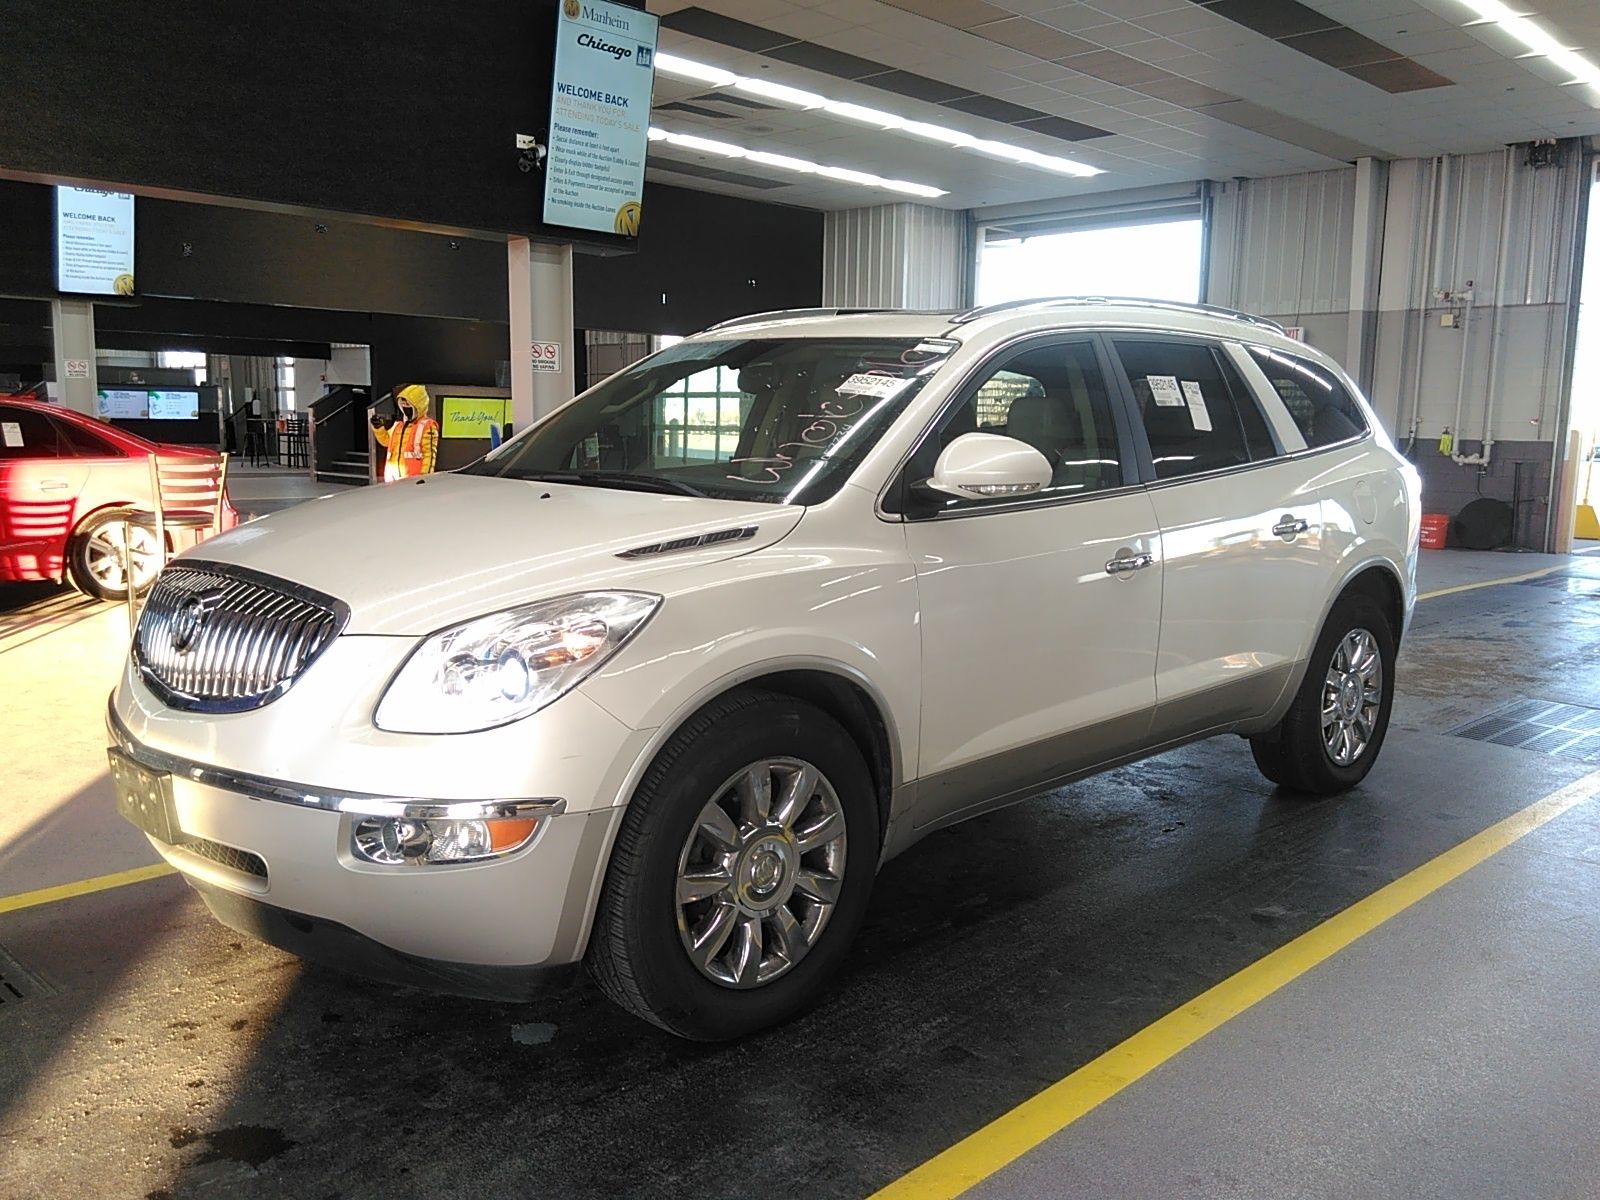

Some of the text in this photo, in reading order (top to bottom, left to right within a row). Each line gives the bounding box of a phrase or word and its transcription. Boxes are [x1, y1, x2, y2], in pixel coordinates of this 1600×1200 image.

[582, 6, 630, 31] Manheim
[577, 33, 632, 60] Chicago
[557, 82, 629, 108] WELCOME BACK
[553, 122, 571, 133] Please
[62, 212, 96, 220] WELCOME
[847, 375, 897, 388] 3952145
[450, 410, 476, 422] Thank
